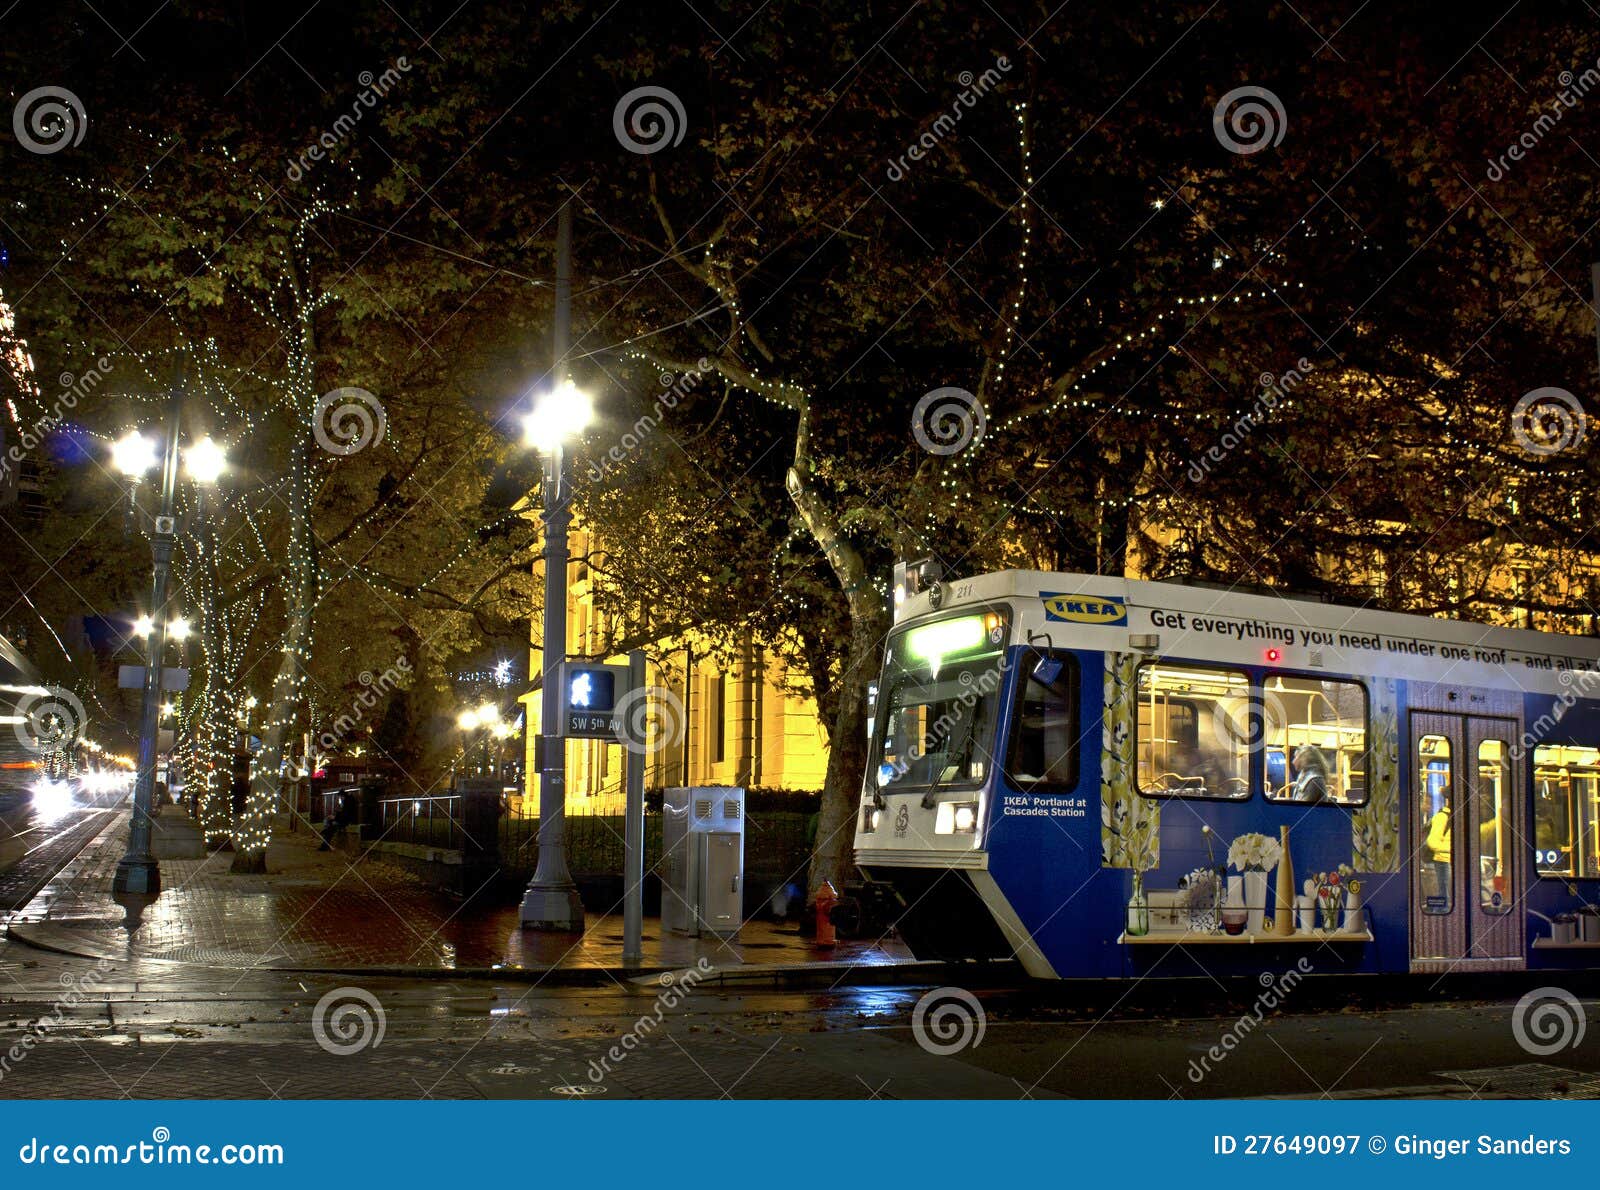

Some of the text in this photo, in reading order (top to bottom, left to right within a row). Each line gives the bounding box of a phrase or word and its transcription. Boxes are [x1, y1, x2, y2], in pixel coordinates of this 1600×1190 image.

[1055, 601, 1118, 616] IKEA
[1150, 610, 1187, 629] Get
[1192, 617, 1295, 645] everything
[1299, 629, 1334, 647] you
[1339, 634, 1382, 650] need
[1387, 639, 1436, 656] under
[1441, 649, 1470, 661] one
[1474, 649, 1507, 664] roof
[1525, 655, 1553, 670] and
[572, 717, 588, 729] SW
[591, 718, 605, 730] 5th
[1033, 797, 1074, 807] Portland
[1076, 798, 1086, 807] at
[1003, 806, 1085, 817] Cascades Station
